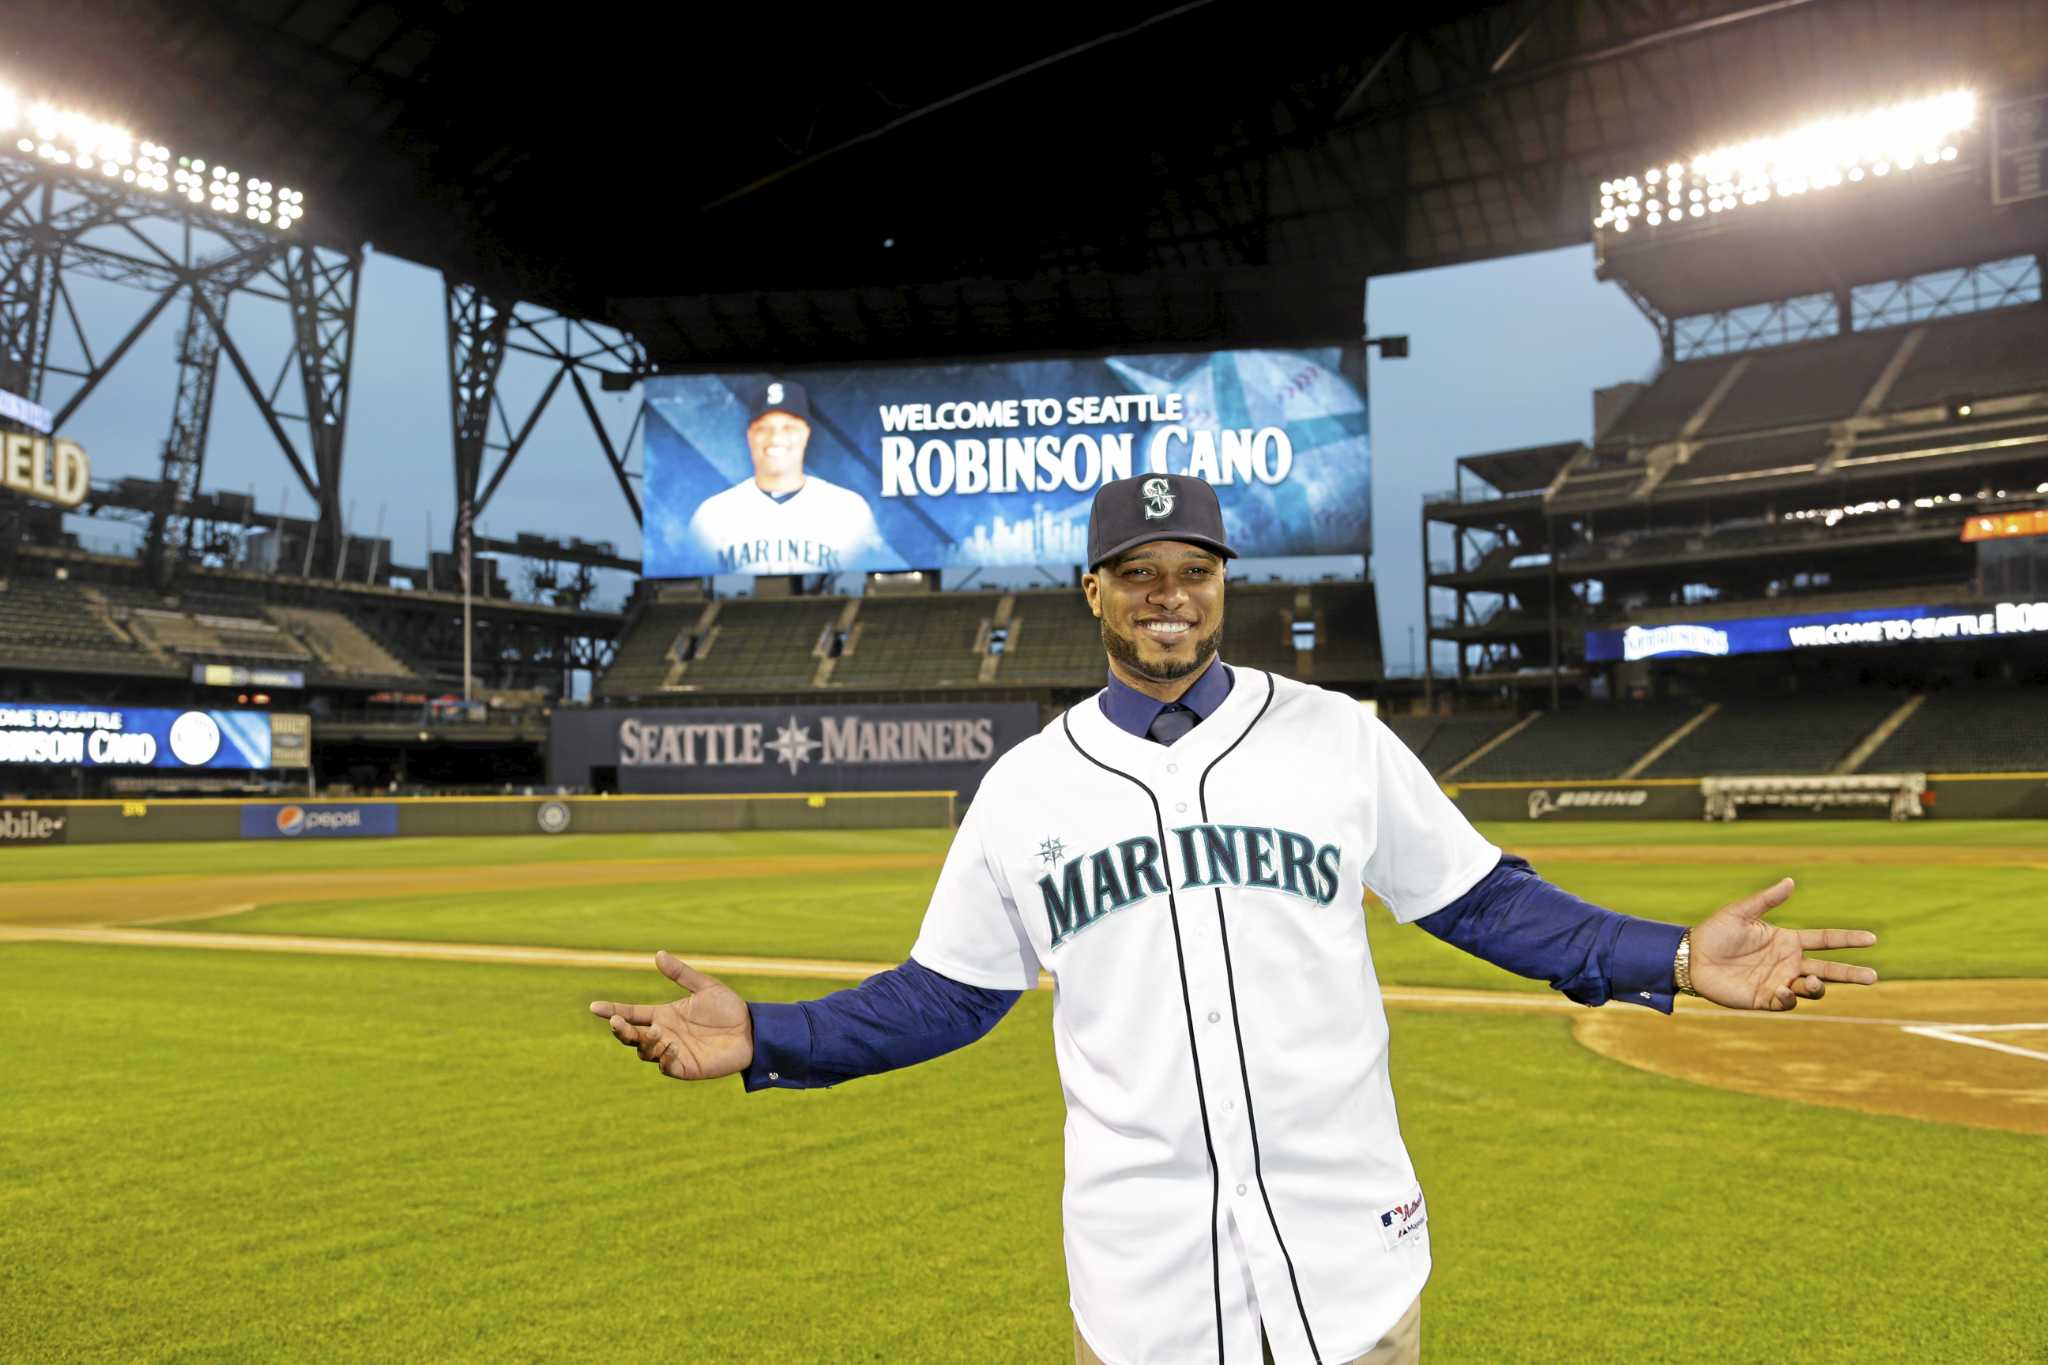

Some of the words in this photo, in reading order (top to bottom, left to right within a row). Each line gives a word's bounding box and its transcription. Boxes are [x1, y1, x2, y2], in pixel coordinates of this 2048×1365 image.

[879, 398, 1019, 431] WELCOME
[1023, 397, 1062, 426] TO
[1066, 394, 1183, 424] SEATTLE
[880, 432, 1135, 497] ROBINSON
[1149, 425, 1293, 487] CANO
[1142, 478, 1176, 520] S
[1789, 621, 1882, 646] WELCOME
[1882, 619, 1912, 640] TO
[1912, 614, 1994, 638] SEATTLE
[35, 709, 59, 728] TO
[619, 716, 764, 766] SEATTLE
[820, 716, 994, 765] MARINERS
[304, 808, 361, 832] pepsi
[1038, 823, 1342, 952] MARINERS
